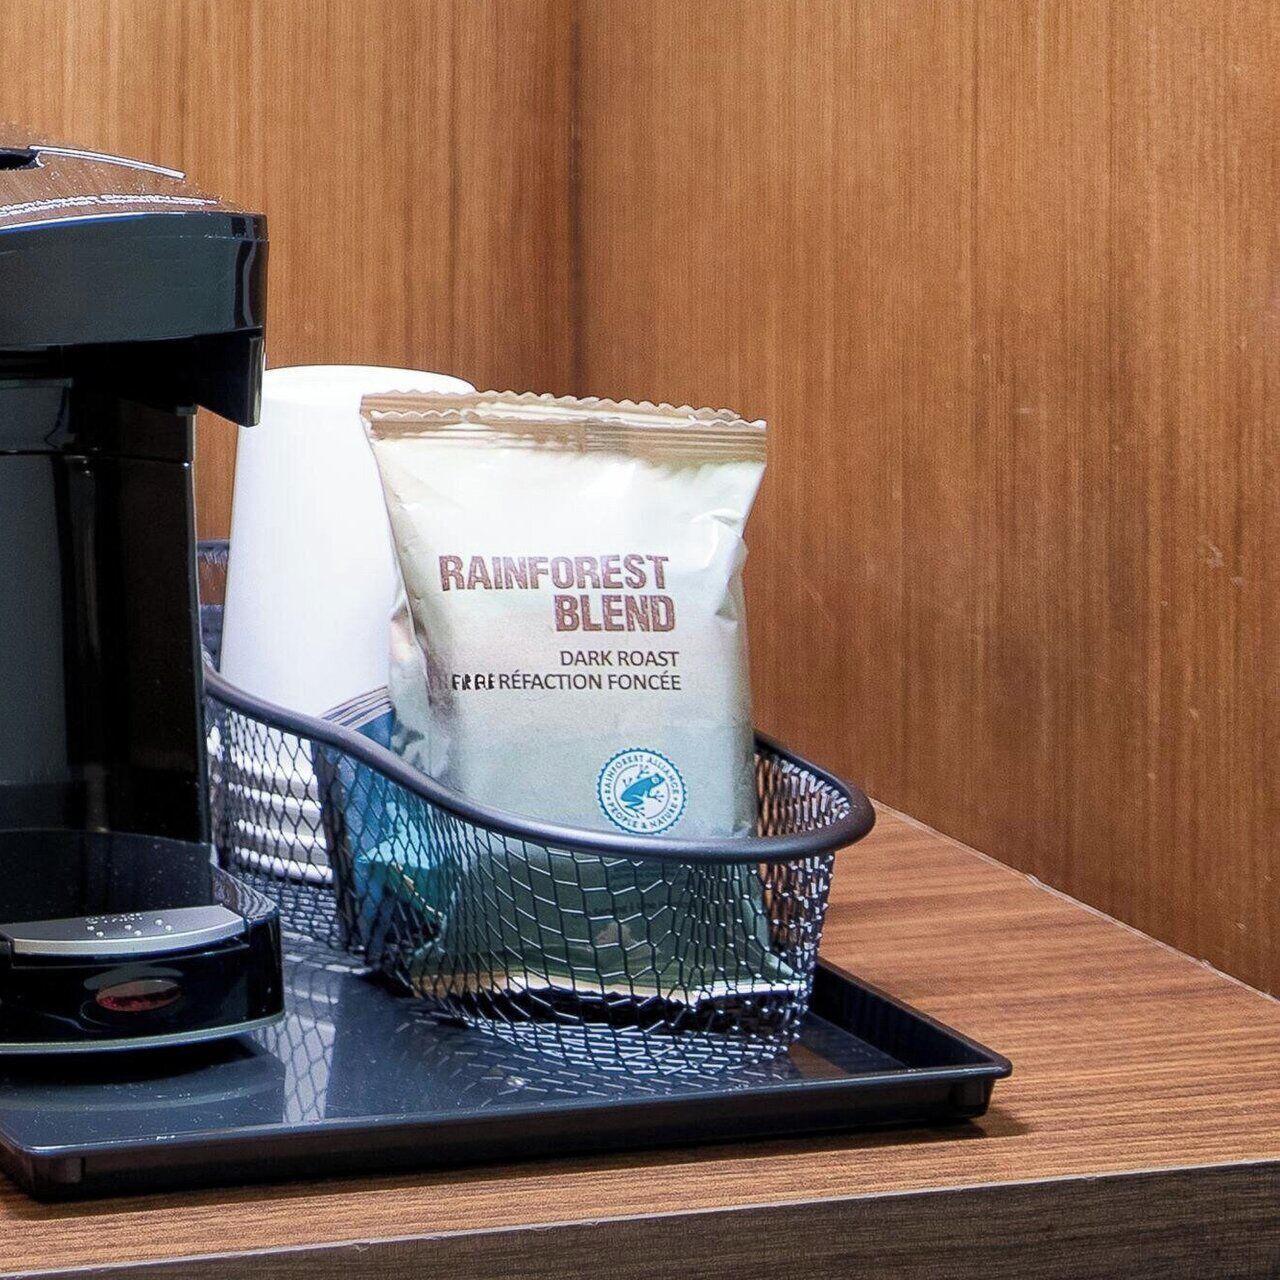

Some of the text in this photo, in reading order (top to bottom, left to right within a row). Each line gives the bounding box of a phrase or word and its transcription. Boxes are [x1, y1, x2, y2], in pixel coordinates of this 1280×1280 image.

[439, 554, 669, 591] RAINFOREST
[555, 595, 675, 632] BLEND
[561, 651, 679, 666] DARK ROAST
[608, 671, 681, 690] FONCÉE
